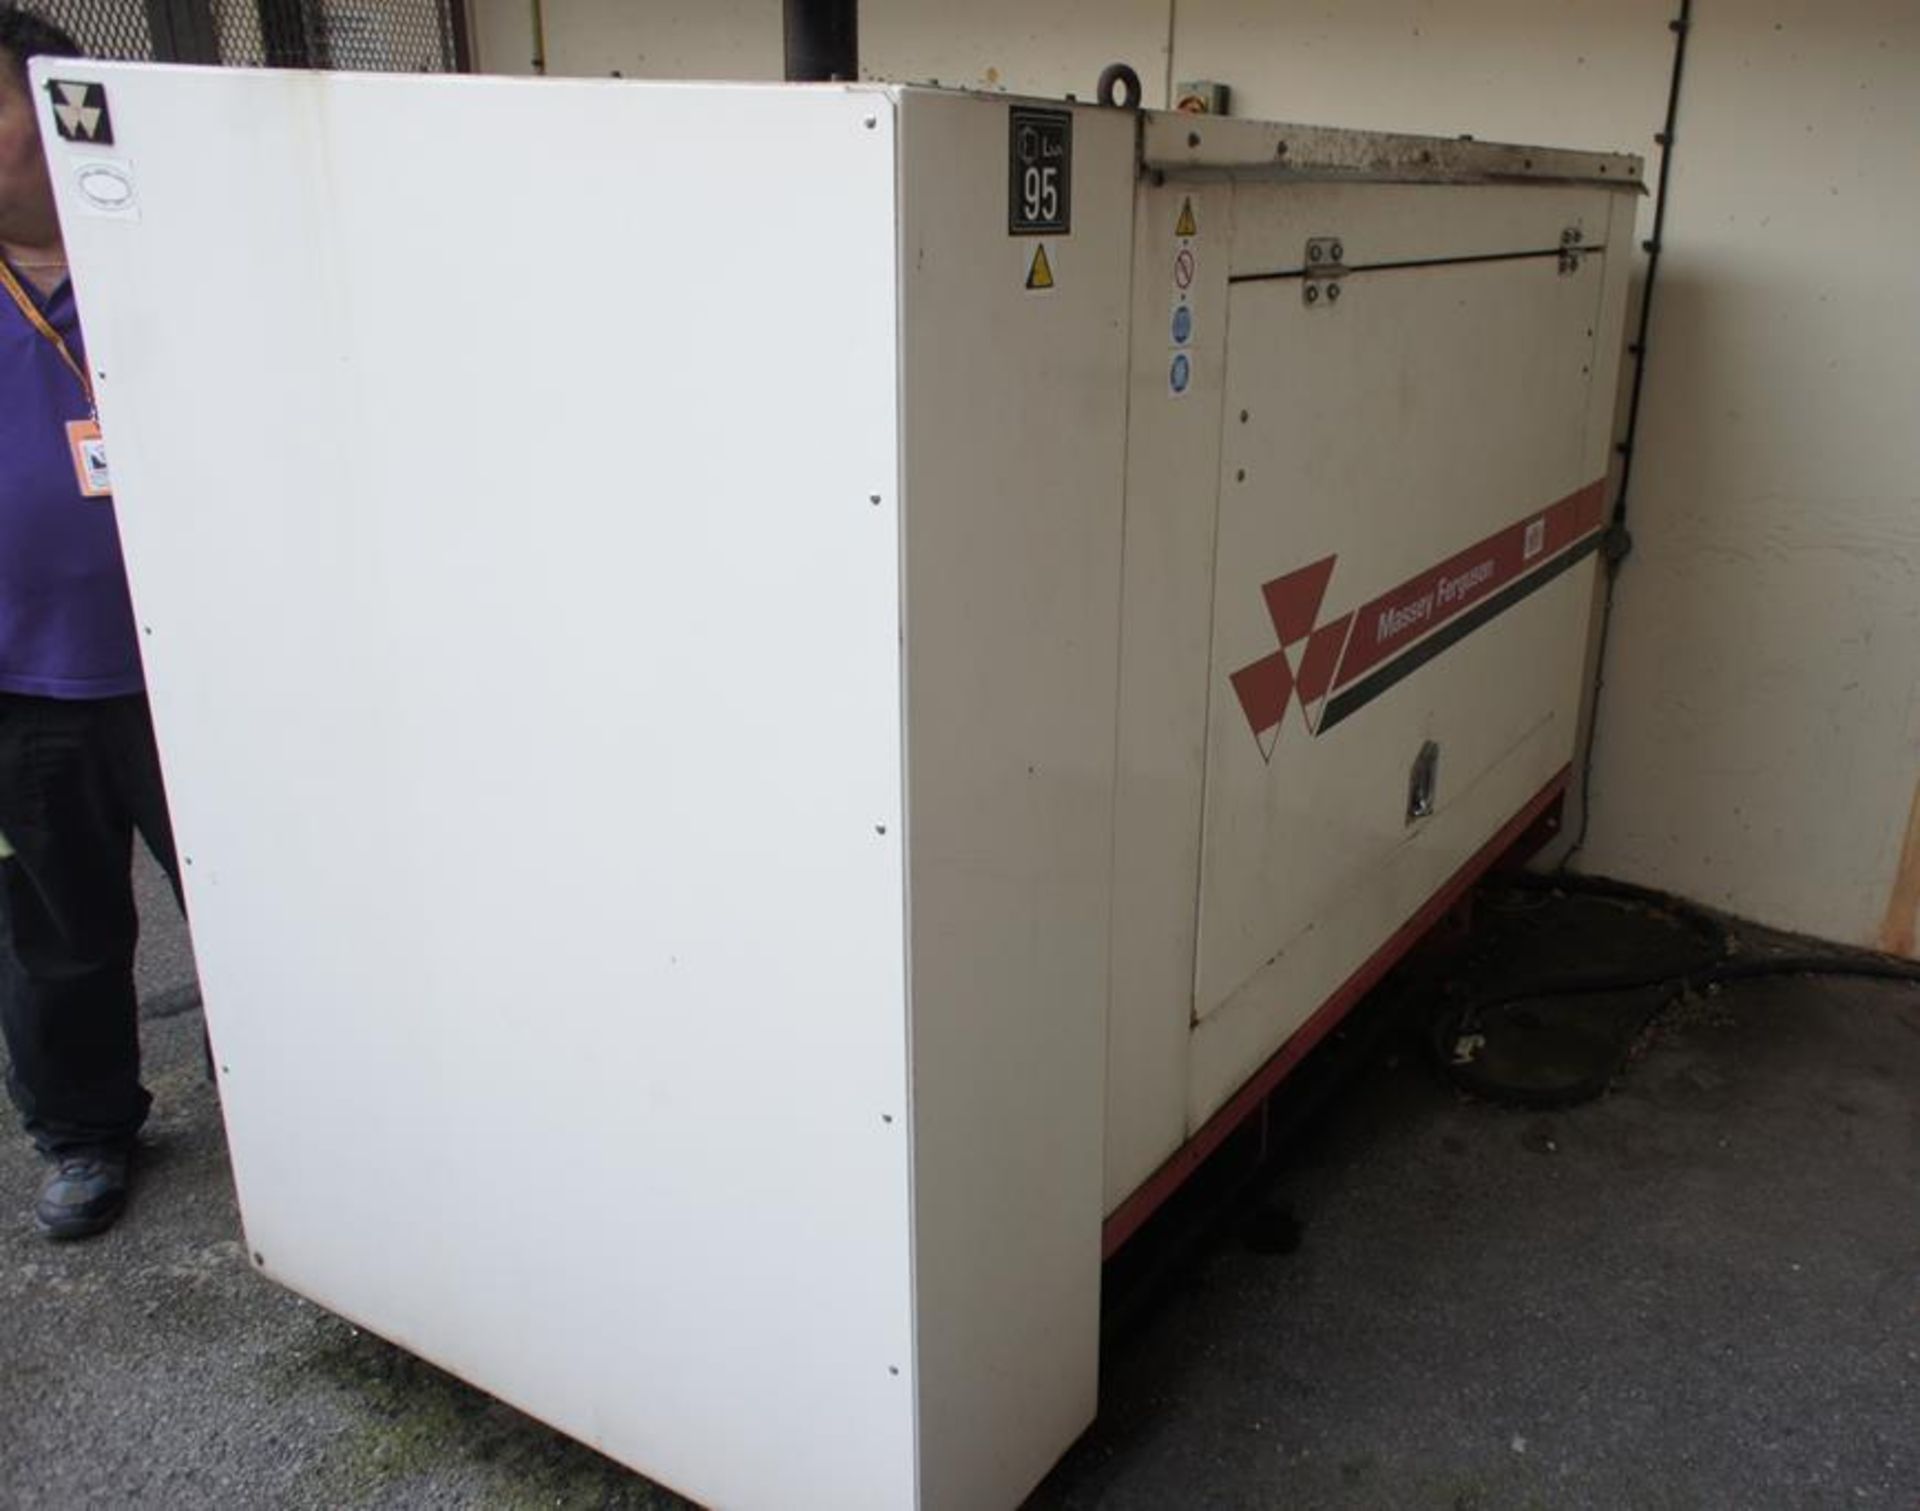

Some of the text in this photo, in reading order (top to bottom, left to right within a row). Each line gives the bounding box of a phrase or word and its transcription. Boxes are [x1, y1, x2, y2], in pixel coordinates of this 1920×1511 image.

[1024, 167, 1057, 220] 95
[1377, 559, 1494, 643] Massey Ferguson
